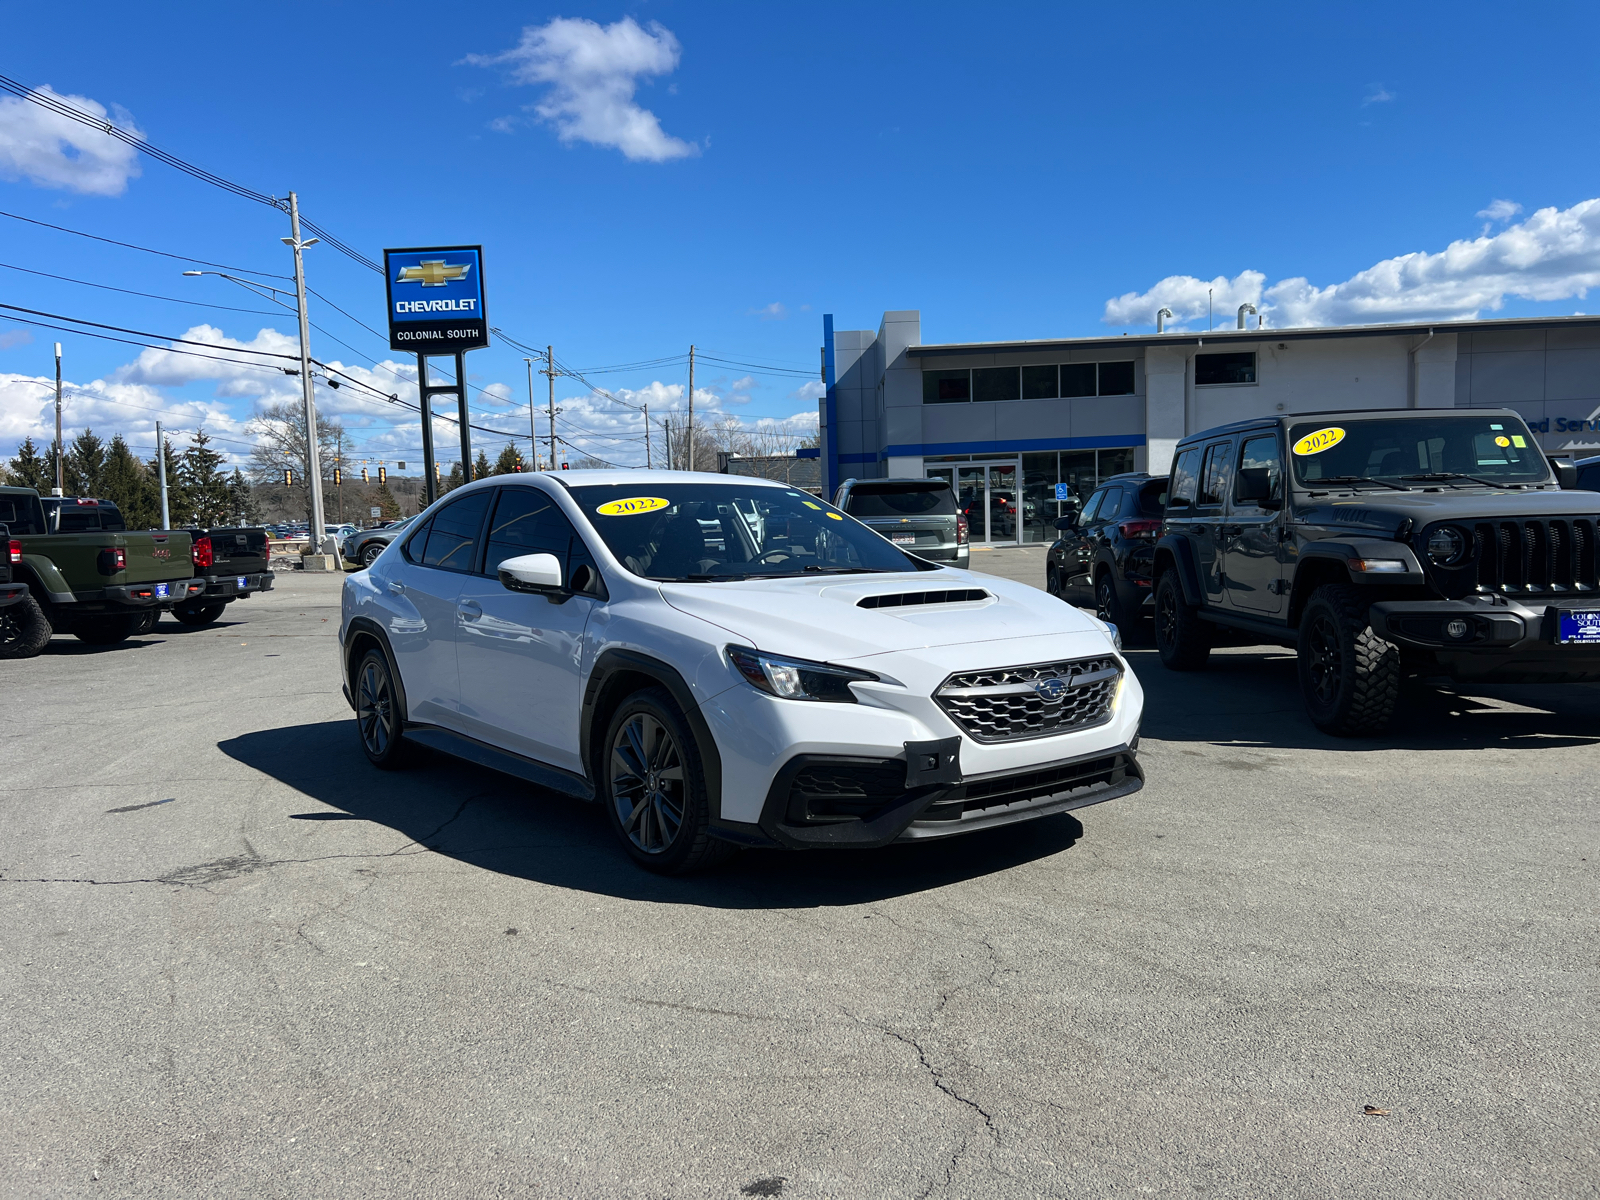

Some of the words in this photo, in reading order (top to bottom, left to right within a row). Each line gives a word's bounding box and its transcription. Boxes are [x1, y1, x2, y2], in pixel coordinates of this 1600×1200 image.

[396, 299, 476, 312] CHEVROLET
[397, 331, 444, 340] COLONIAL
[447, 329, 478, 338] SOUTH
[1523, 418, 1550, 433] ed
[1304, 430, 1336, 452] 2022
[613, 499, 658, 513] 2022
[152, 547, 171, 559] Jeep
